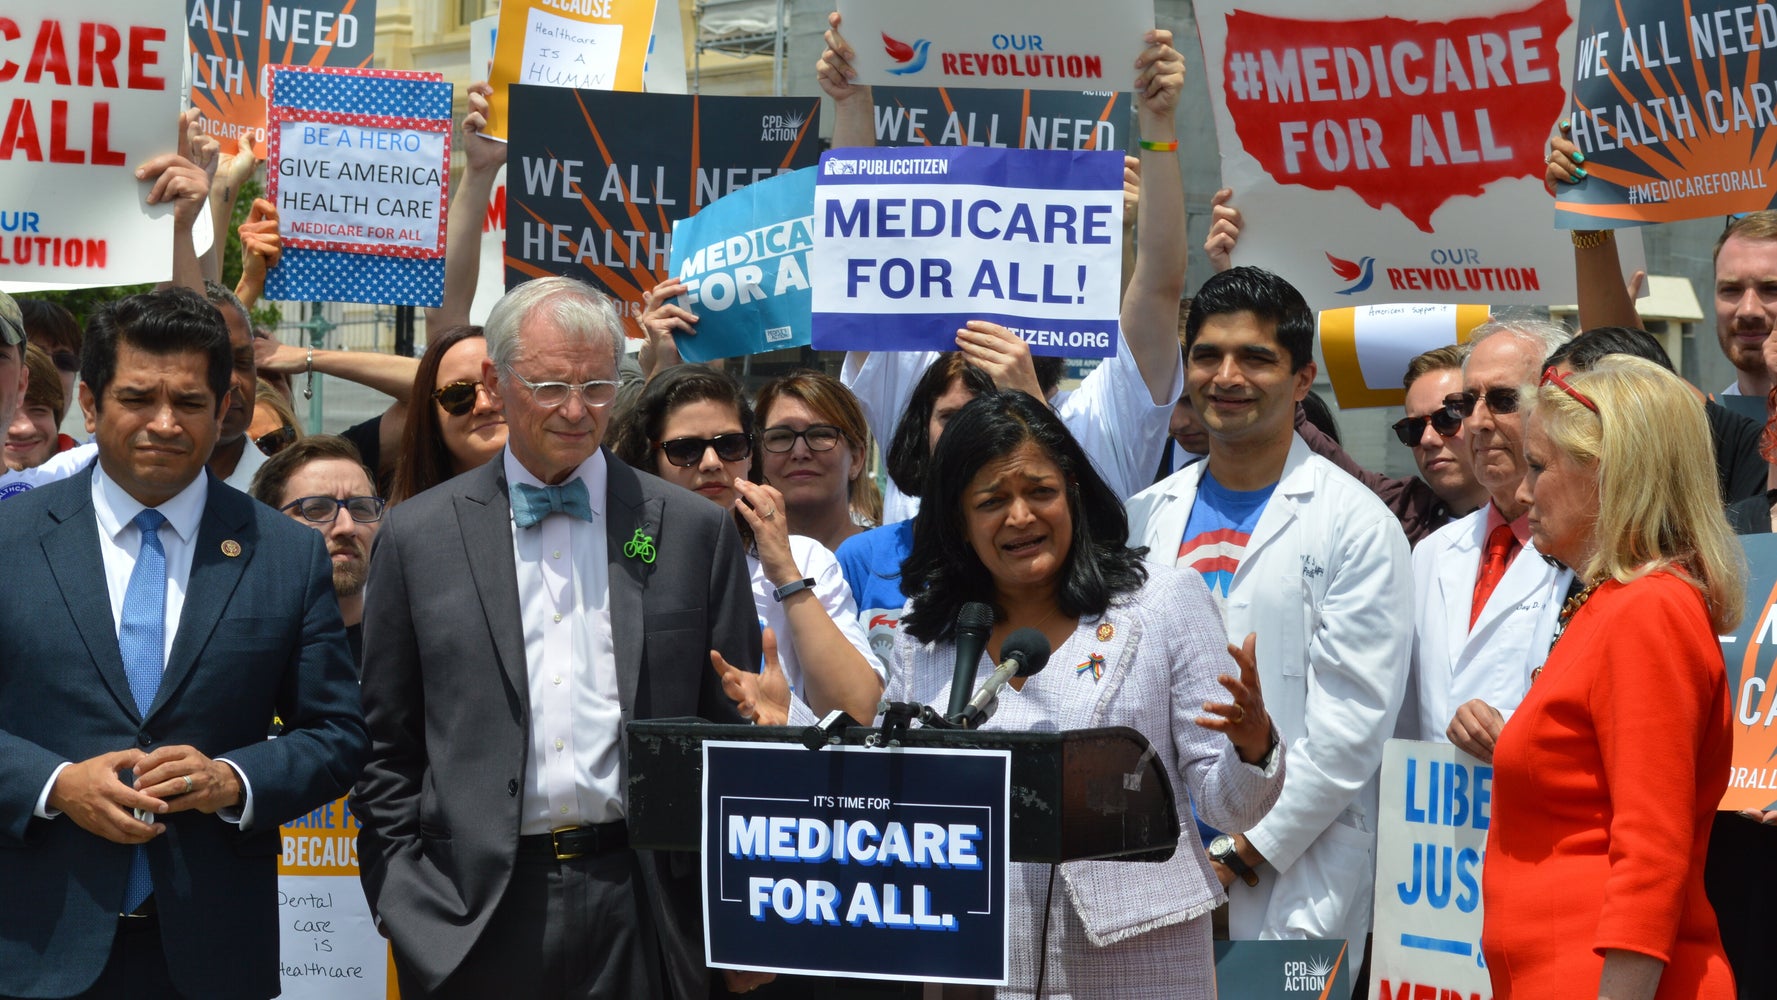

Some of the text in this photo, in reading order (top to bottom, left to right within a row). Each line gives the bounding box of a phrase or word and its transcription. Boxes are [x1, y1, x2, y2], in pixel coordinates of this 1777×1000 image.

[189, 0, 358, 48] ALL NEED
[536, 22, 597, 45] Healthcare
[992, 34, 1043, 51] OUR
[1578, 3, 1777, 81] WE ALL NEED
[574, 54, 586, 65] A
[942, 53, 1101, 78] REVOLUTION
[1230, 27, 1550, 103] #MEDICARE
[528, 62, 605, 89] HUMAN
[762, 115, 783, 129] CPD
[874, 105, 1115, 152] WE ALL NEED
[1572, 80, 1777, 153] HEALTH CAR
[0, 99, 126, 166] ALL
[304, 127, 421, 152] BE A HERO
[761, 129, 798, 141] ACTION
[1280, 109, 1513, 174] FOR ALL
[280, 158, 440, 187] GIVE AMERICA
[522, 156, 584, 199] WE
[600, 163, 676, 205] ALL
[858, 159, 948, 175] PUBLICCITIZEN
[1629, 168, 1767, 205] #MEDICAREFORALL
[283, 191, 433, 219] HEALTH CARE
[291, 221, 422, 241] MEDICARE FOR ALL
[824, 199, 1112, 244] MEDICARE
[523, 222, 671, 271] HEALTH
[680, 218, 815, 281] MEDICA
[1430, 248, 1479, 265] OUR
[677, 264, 767, 312] FOR
[847, 258, 1087, 304] FOR ALL!
[1387, 267, 1540, 292] REVOLUTION
[813, 796, 890, 810] IT'S TIME FOR
[729, 815, 982, 869] MEDICARE
[750, 877, 958, 931] FOR ALL.
[294, 919, 335, 933] care
[314, 938, 333, 952] is
[1284, 961, 1307, 976] CPD
[1284, 976, 1325, 992] ACTION
